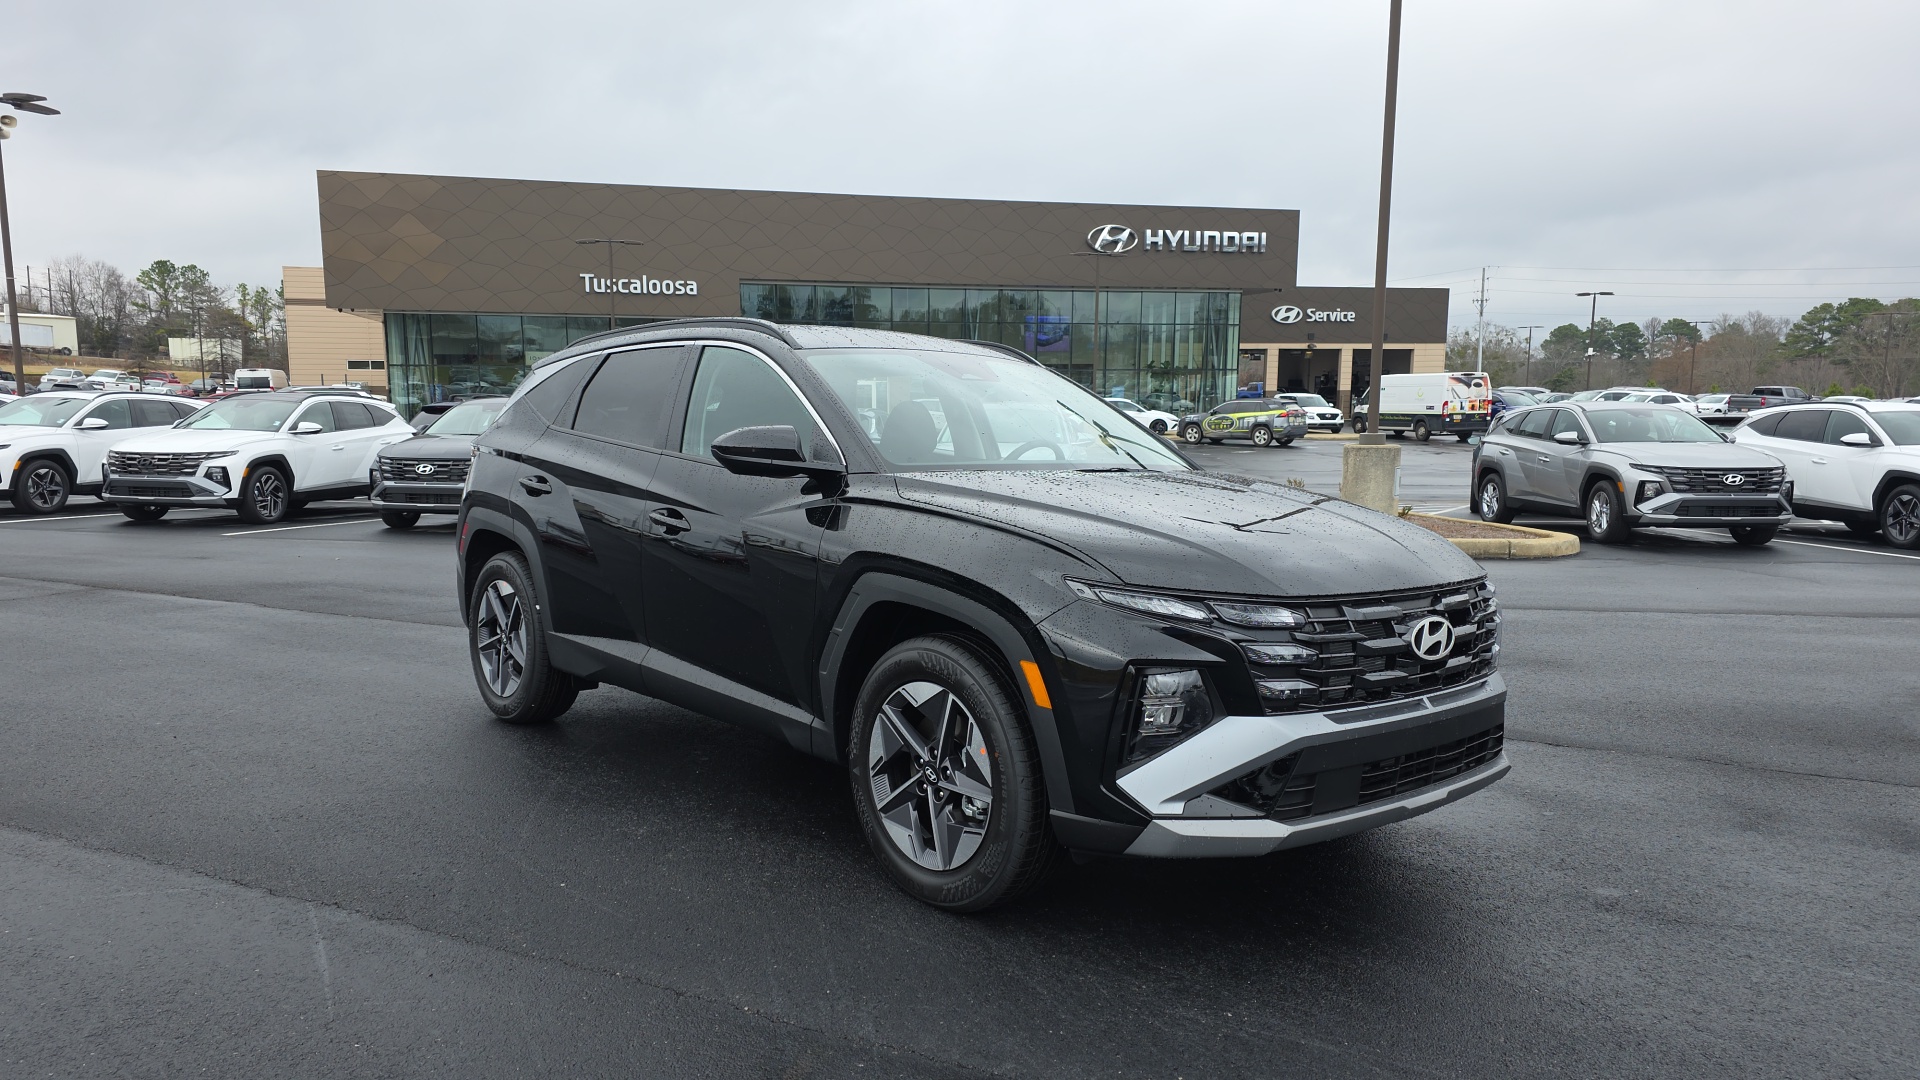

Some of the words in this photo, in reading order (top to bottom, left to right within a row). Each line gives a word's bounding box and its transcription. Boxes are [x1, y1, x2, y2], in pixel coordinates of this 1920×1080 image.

[1145, 229, 1267, 253] HYUNDAI
[579, 273, 698, 295] Tuscaloosa
[1306, 308, 1356, 322] Service
